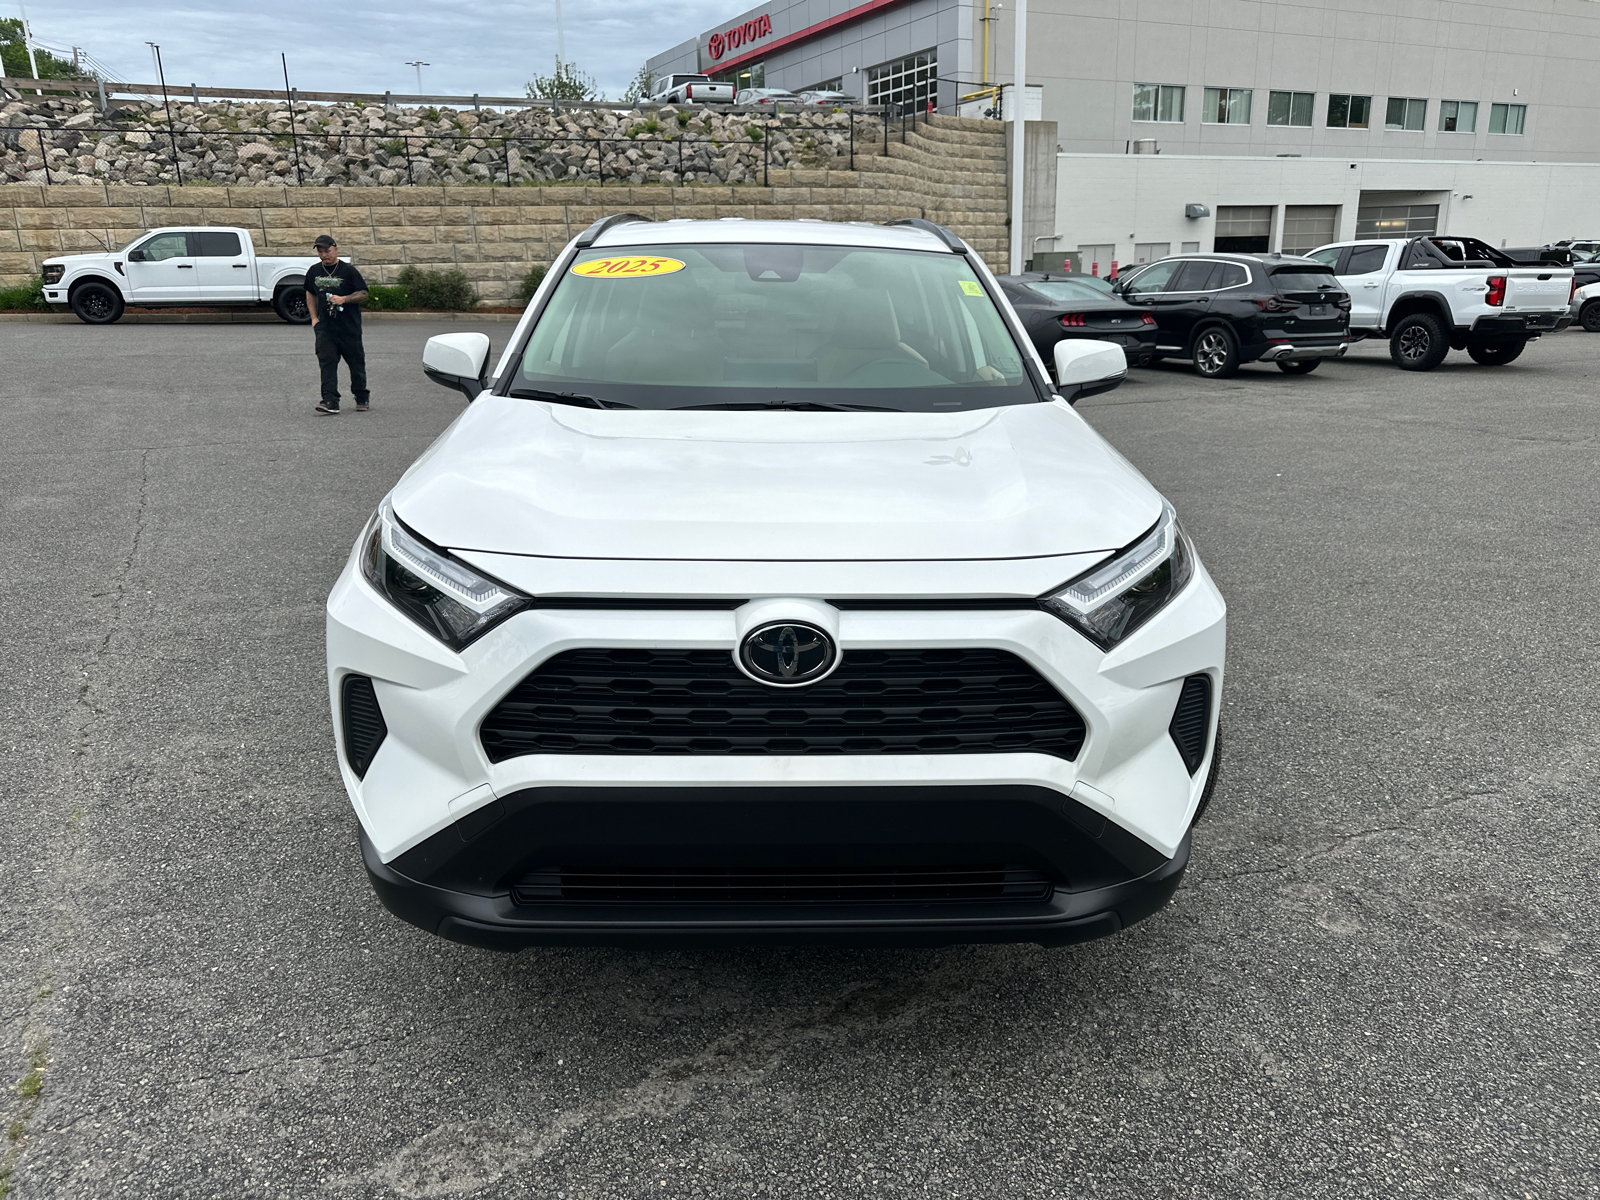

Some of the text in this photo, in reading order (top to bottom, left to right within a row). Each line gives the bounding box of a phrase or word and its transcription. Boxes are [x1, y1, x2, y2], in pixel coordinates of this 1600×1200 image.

[724, 13, 772, 51] TOYOTA
[586, 260, 667, 274] 2025
[1515, 284, 1568, 292] CHEVROLET
